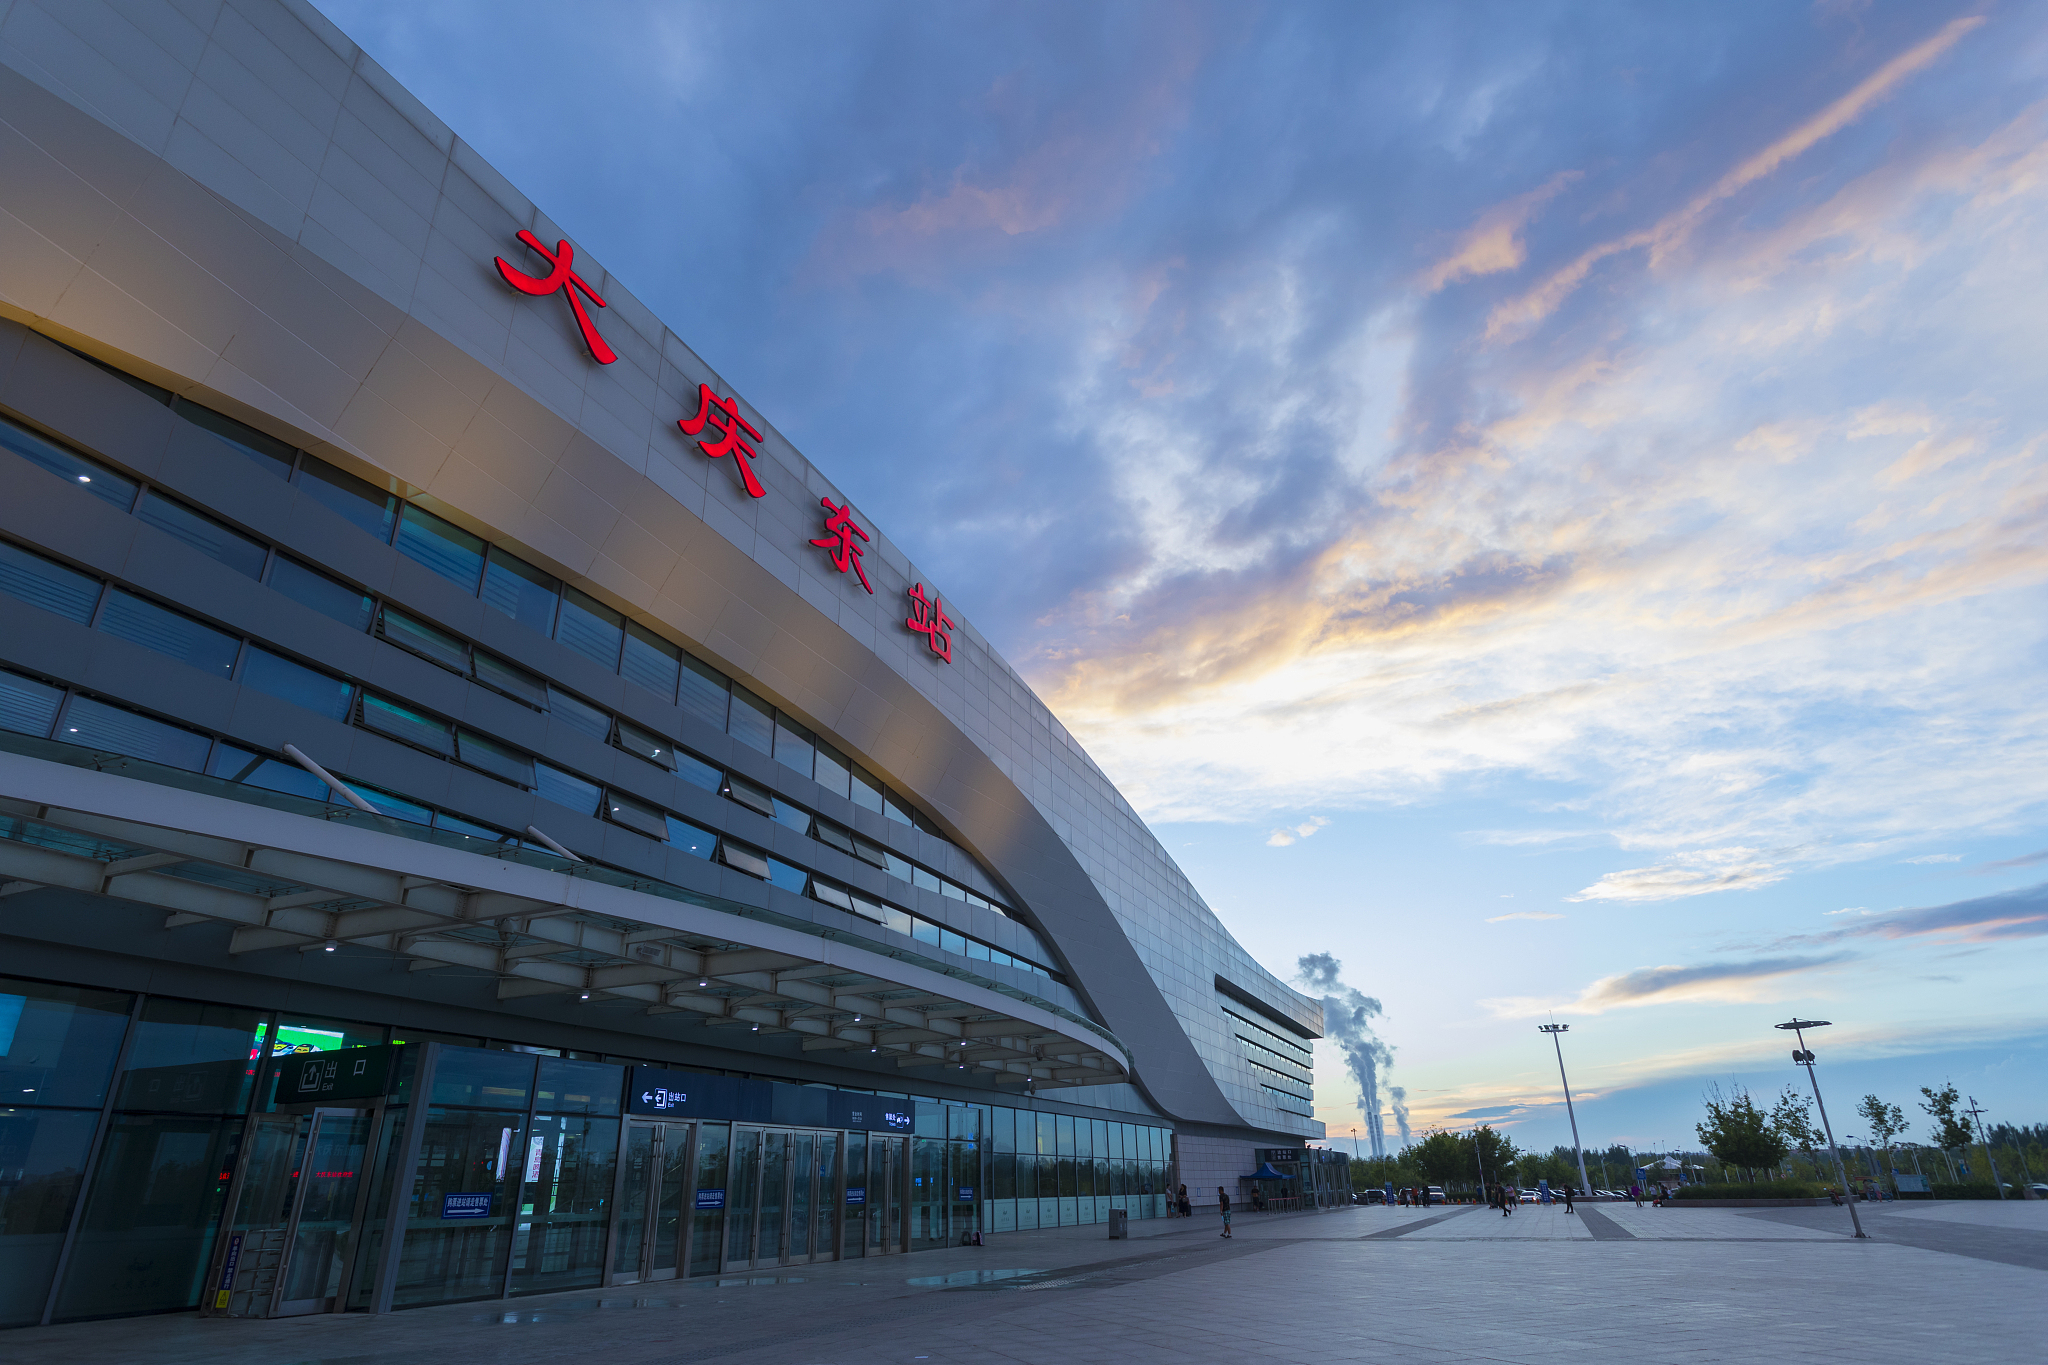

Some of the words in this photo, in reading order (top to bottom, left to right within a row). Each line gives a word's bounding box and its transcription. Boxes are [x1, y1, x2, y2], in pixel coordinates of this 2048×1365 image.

[493, 229, 954, 665] 大庆东站
[324, 1059, 367, 1079] 出口
[321, 1083, 334, 1091] Exit
[668, 1091, 687, 1103] 出站口
